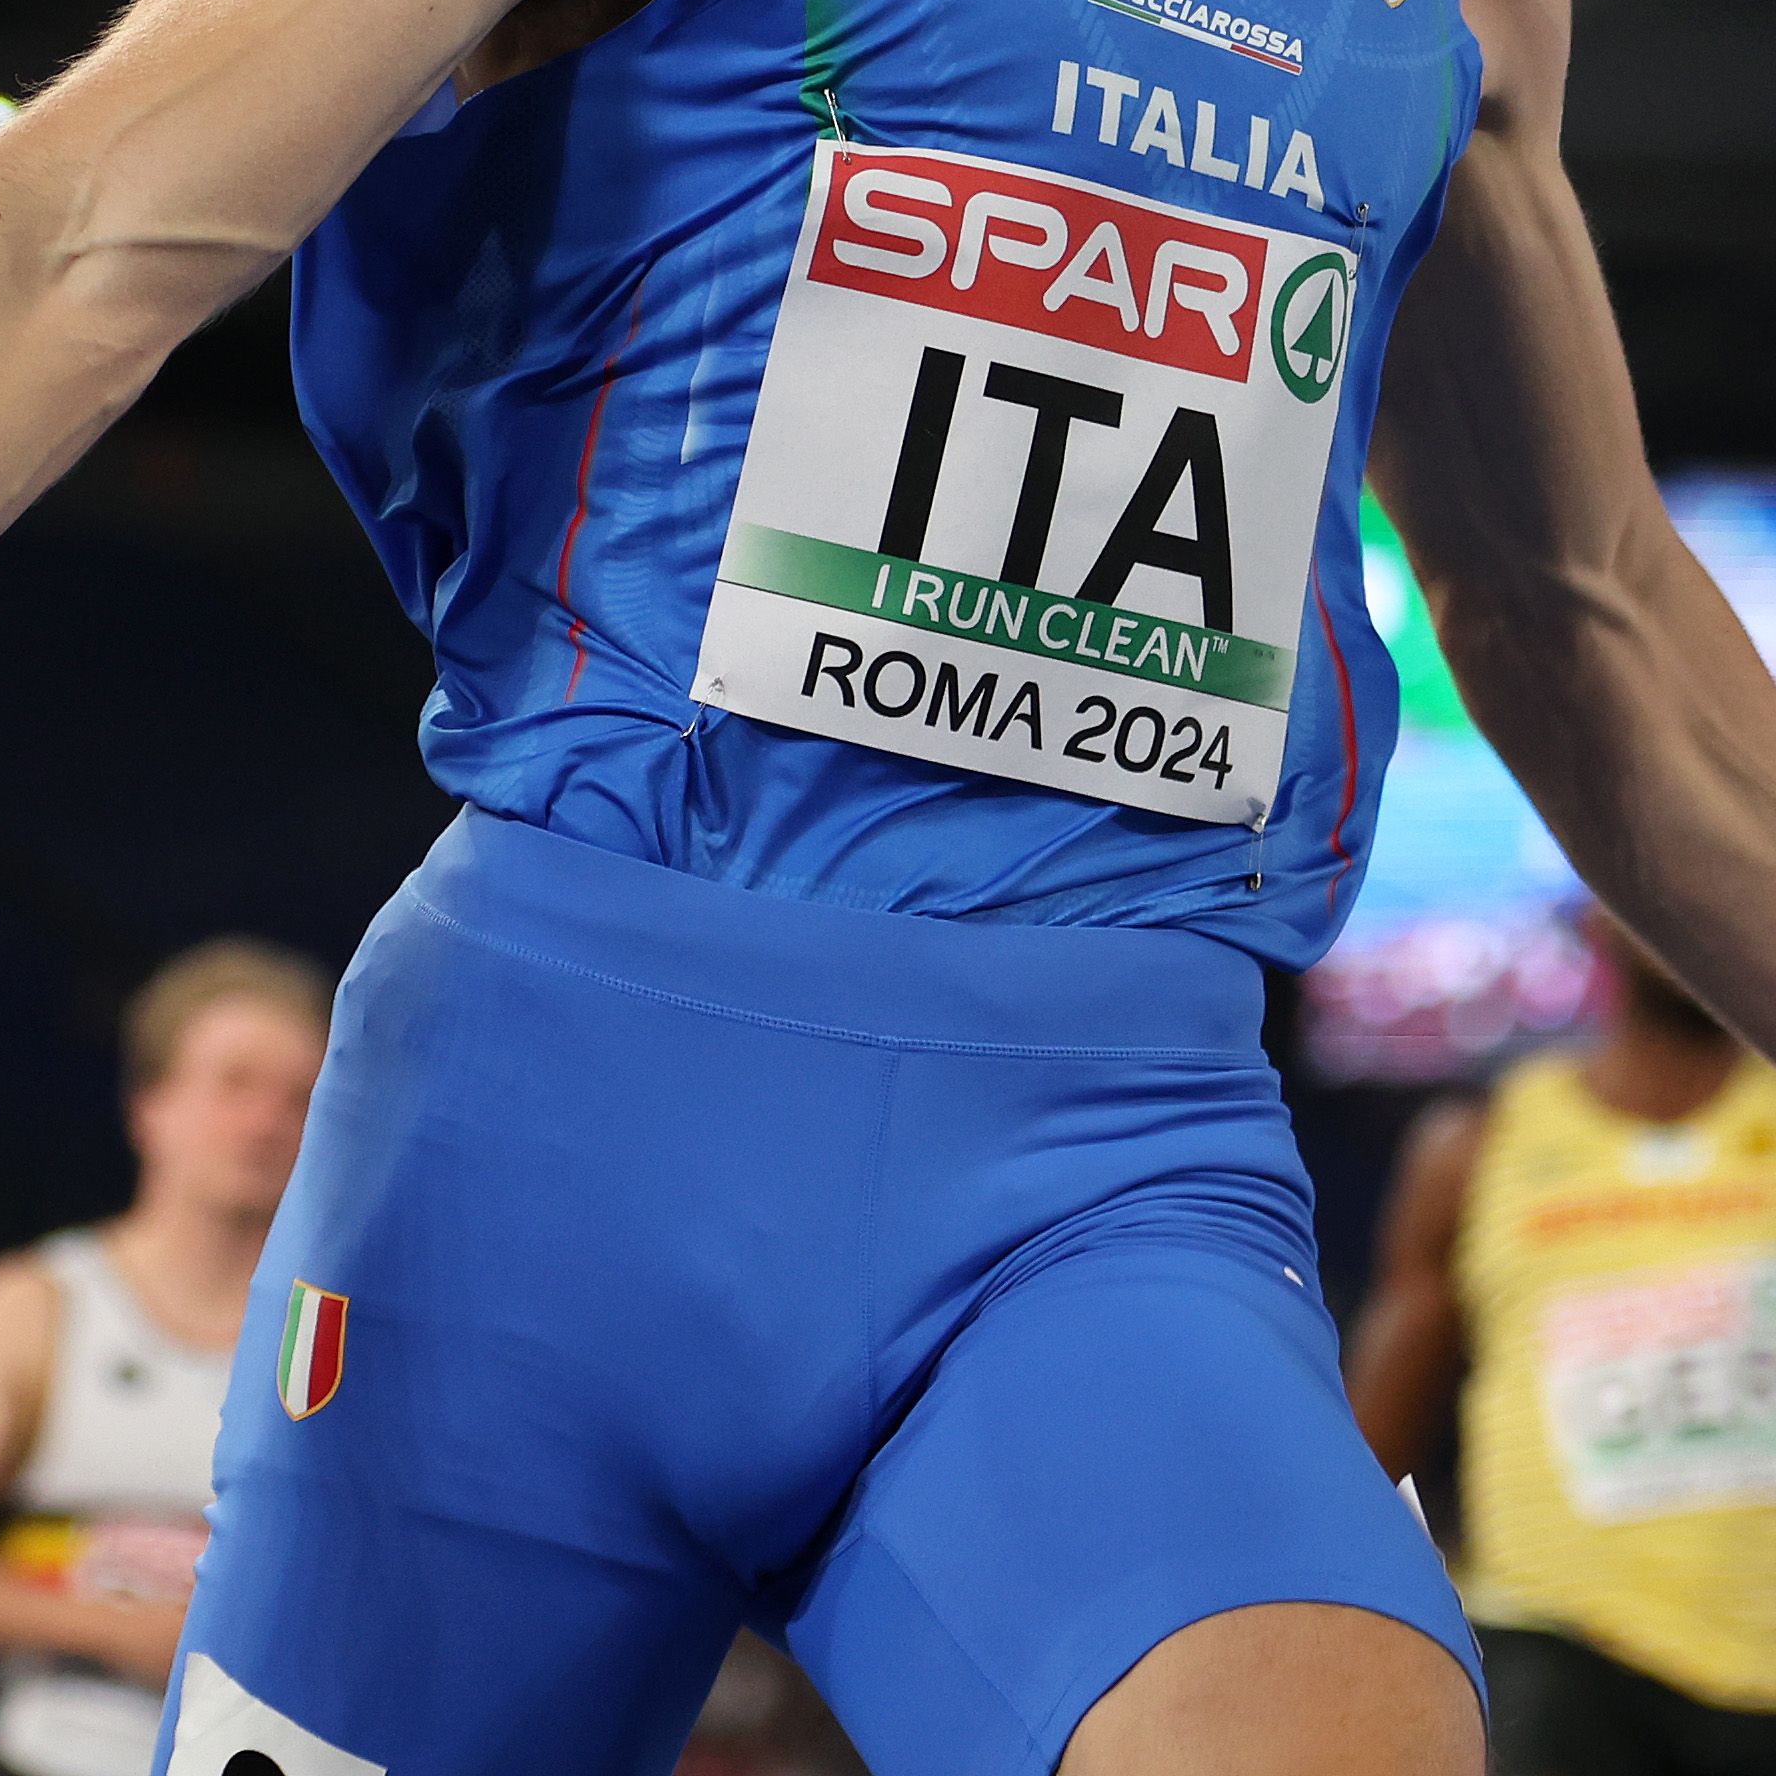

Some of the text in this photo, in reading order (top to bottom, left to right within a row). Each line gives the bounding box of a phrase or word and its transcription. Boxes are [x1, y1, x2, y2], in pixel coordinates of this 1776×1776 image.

[1052, 60, 1324, 213] ITALIA
[832, 169, 1249, 356] SPAR
[877, 346, 1234, 636] ITA
[870, 563, 891, 610] I
[902, 571, 1030, 640] RUN
[800, 632, 1234, 791] ROMA 2024
